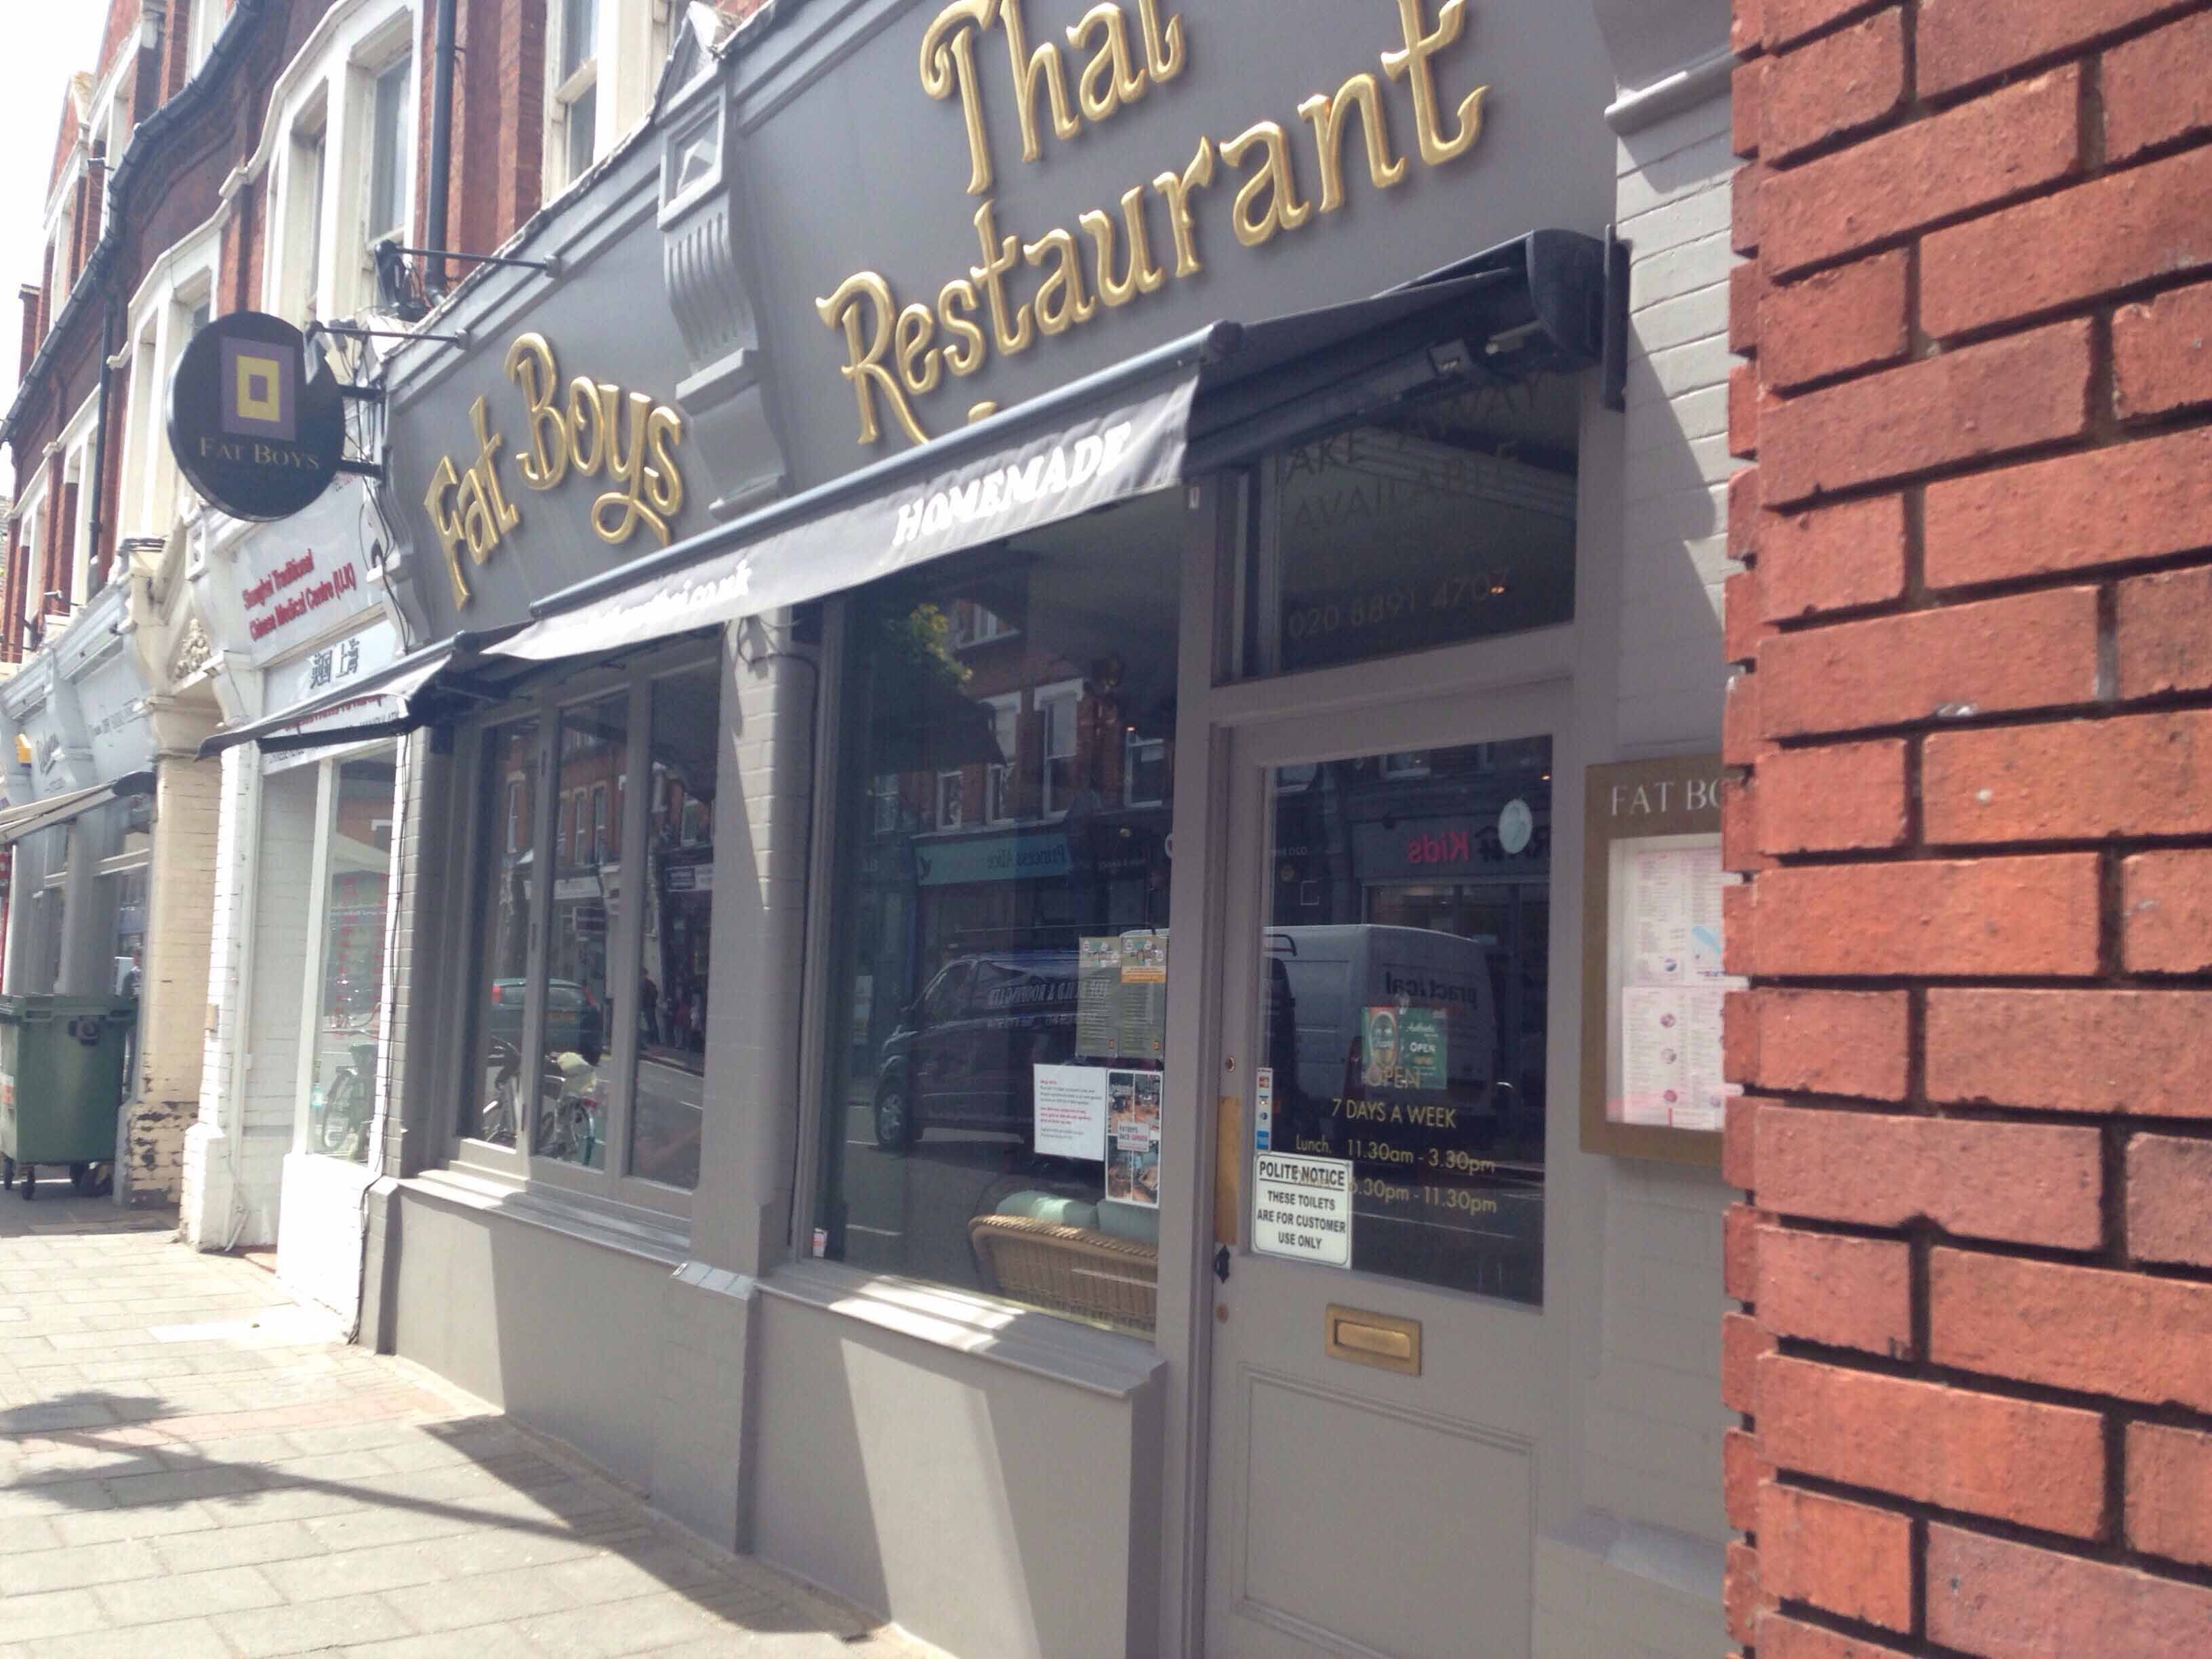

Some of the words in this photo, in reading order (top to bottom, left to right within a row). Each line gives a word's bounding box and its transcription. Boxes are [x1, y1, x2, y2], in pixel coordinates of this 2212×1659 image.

[814, 0, 1490, 445] Restaurant
[200, 437, 244, 461] FAT
[254, 444, 321, 469] BOYS
[423, 395, 520, 611] Fat
[504, 333, 683, 547] Boys
[893, 423, 1132, 546] HOMEMADE
[1612, 779, 1675, 817] FAT
[1410, 1042, 1435, 1052] OPEN
[1366, 1063, 1421, 1089] OPEN
[1332, 1098, 1343, 1117] 7
[1346, 1099, 1386, 1122] DAYS
[1390, 1105, 1402, 1123] A
[1407, 1105, 1456, 1128] WEEK
[1348, 1139, 1414, 1164] 11.30am
[1428, 1148, 1496, 1176] 3.30pm
[1259, 1161, 1298, 1180] POLITE
[1300, 1166, 1345, 1186] NOTICE
[1267, 1190, 1296, 1205] THESE
[1298, 1195, 1335, 1210] TOILETS
[1424, 1186, 1497, 1215] 11.30pm
[1257, 1209, 1274, 1222] ARE
[1276, 1211, 1294, 1225] FOR
[1296, 1214, 1346, 1233] CUSTOMER
[1278, 1232, 1296, 1245] USE
[1298, 1235, 1322, 1249] ONLY
